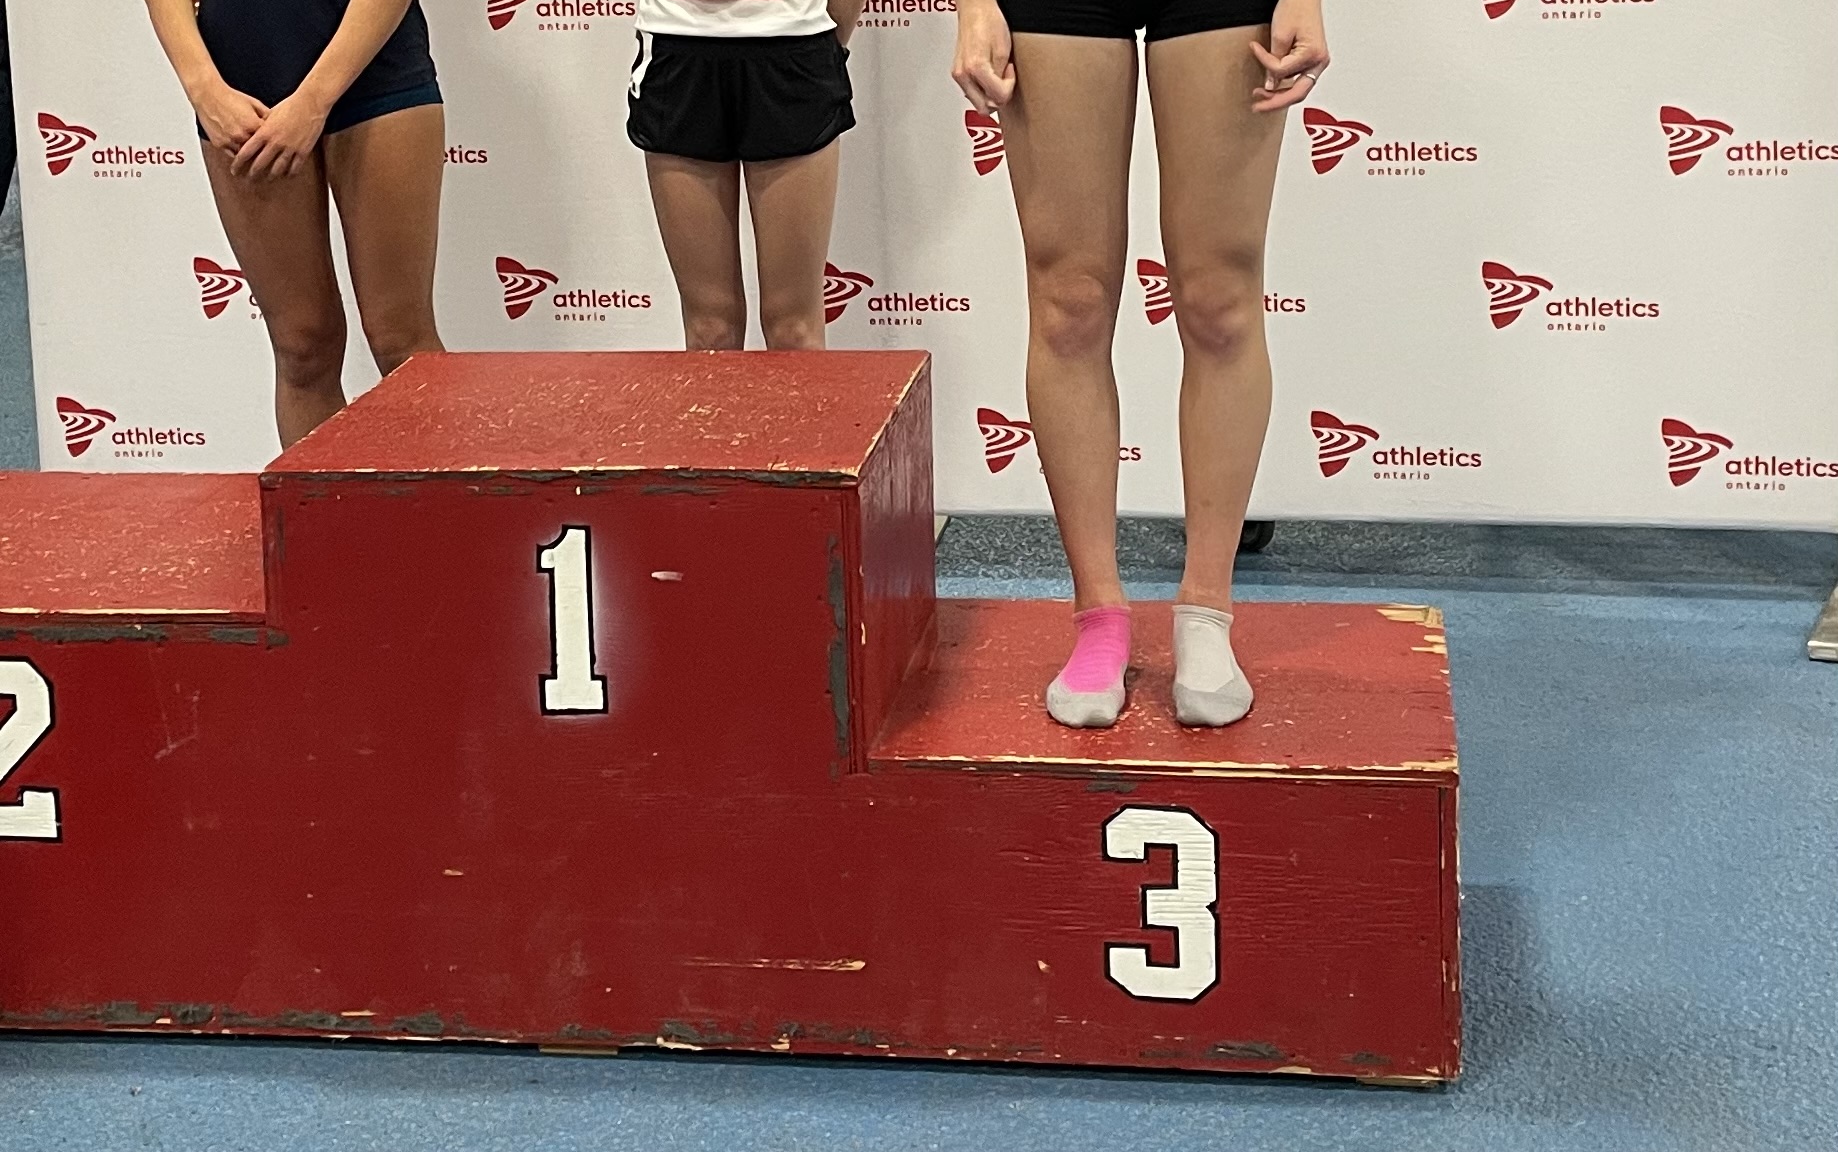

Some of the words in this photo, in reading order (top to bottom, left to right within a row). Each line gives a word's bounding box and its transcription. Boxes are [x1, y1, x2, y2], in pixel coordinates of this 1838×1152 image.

[1542, 9, 1601, 19] ontario
[538, 22, 589, 30] ontario
[856, 16, 911, 28] ontario
[92, 146, 184, 164] athletics
[1366, 142, 1477, 161] athletics
[1726, 140, 1838, 161] athletics
[94, 169, 141, 178] ontario
[1368, 166, 1425, 176] ontario
[1728, 166, 1788, 176] ontario
[553, 289, 651, 308] athletics
[868, 292, 970, 312] athletics
[1546, 297, 1659, 317] athletics
[555, 312, 605, 321] ontario
[870, 316, 922, 326] ontario
[1547, 322, 1605, 331] ontario
[112, 427, 205, 445] athletics
[115, 449, 163, 457] ontario
[1372, 446, 1481, 467] athletics
[1726, 456, 1838, 477] athletics
[1374, 471, 1430, 480] ontario
[1726, 481, 1785, 491] ontario
[537, 525, 608, 714] 1
[1102, 803, 1219, 1002] 3
